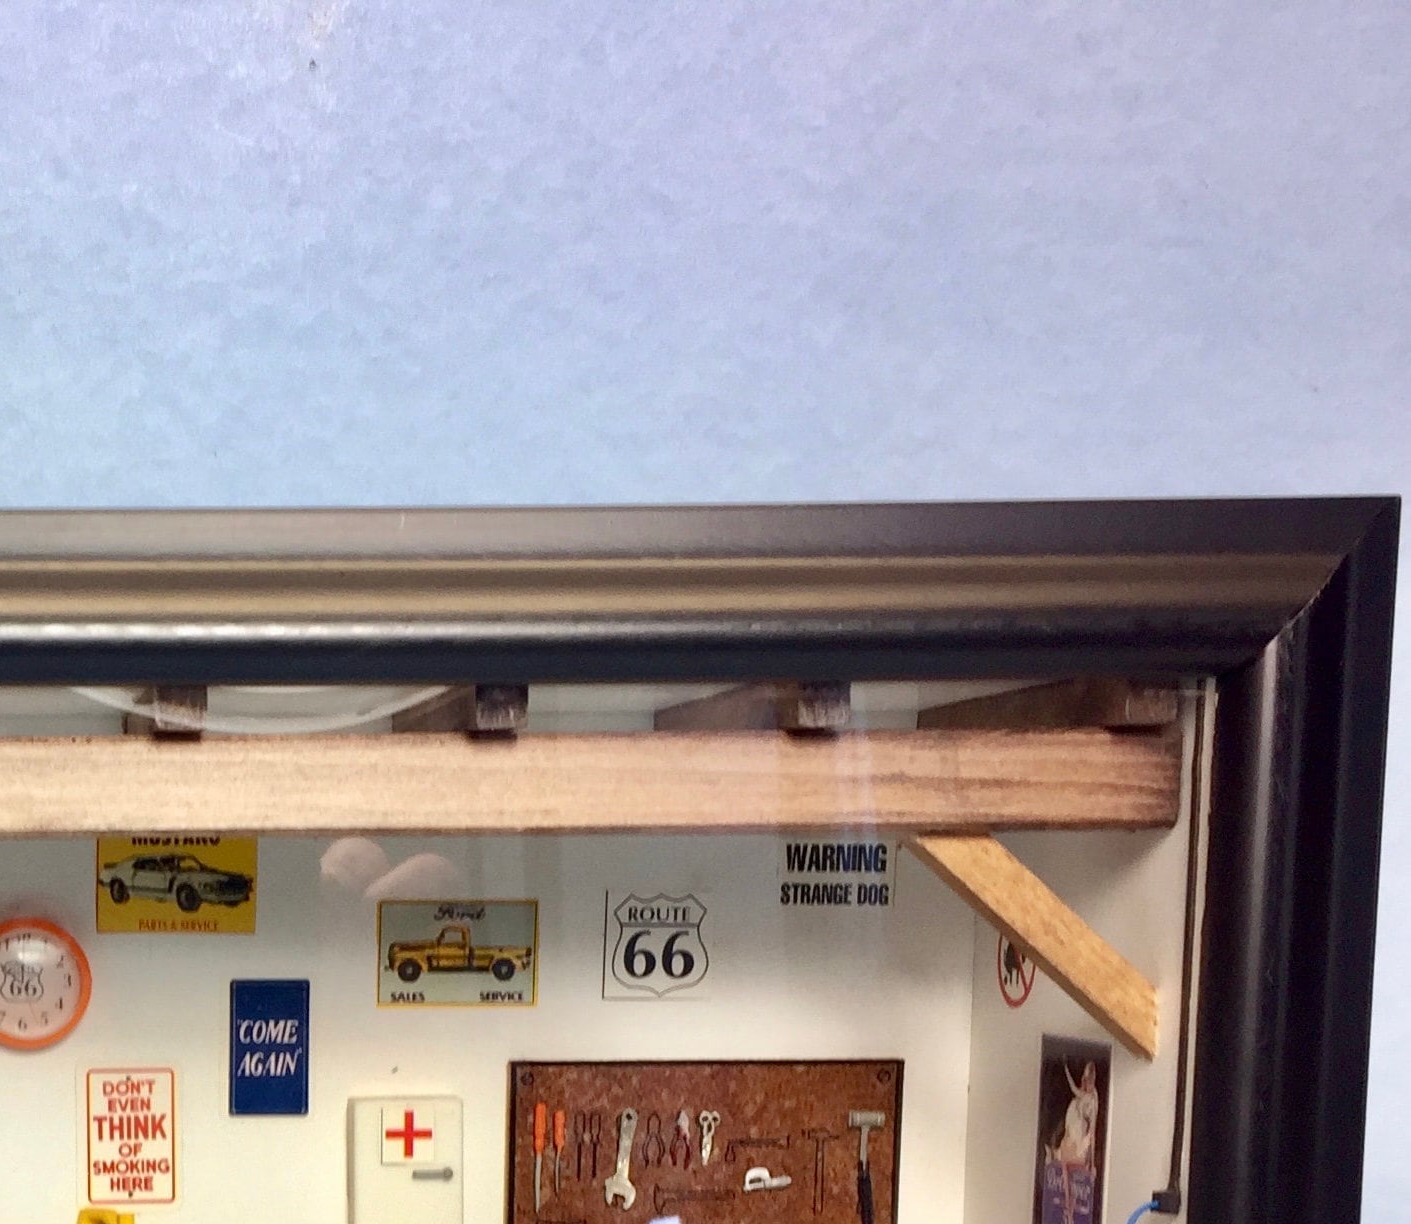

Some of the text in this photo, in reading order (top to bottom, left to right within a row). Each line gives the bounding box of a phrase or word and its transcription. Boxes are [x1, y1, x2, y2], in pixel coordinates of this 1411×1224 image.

[786, 843, 887, 873] WARNING
[780, 883, 889, 906] STRANGE DOG
[628, 906, 690, 922] ROUTE
[139, 919, 167, 931] PARTS
[181, 919, 218, 931] SERVICE
[623, 929, 695, 979] 66
[390, 991, 425, 1003] SALES
[480, 991, 524, 1003] SERVICE
[103, 1080, 155, 1096] DON'T
[108, 1098, 151, 1112] EVEN
[93, 1114, 167, 1141] THINK
[118, 1143, 142, 1158] OF
[93, 1158, 170, 1175] SMOKING
[110, 1177, 153, 1192] HERE
